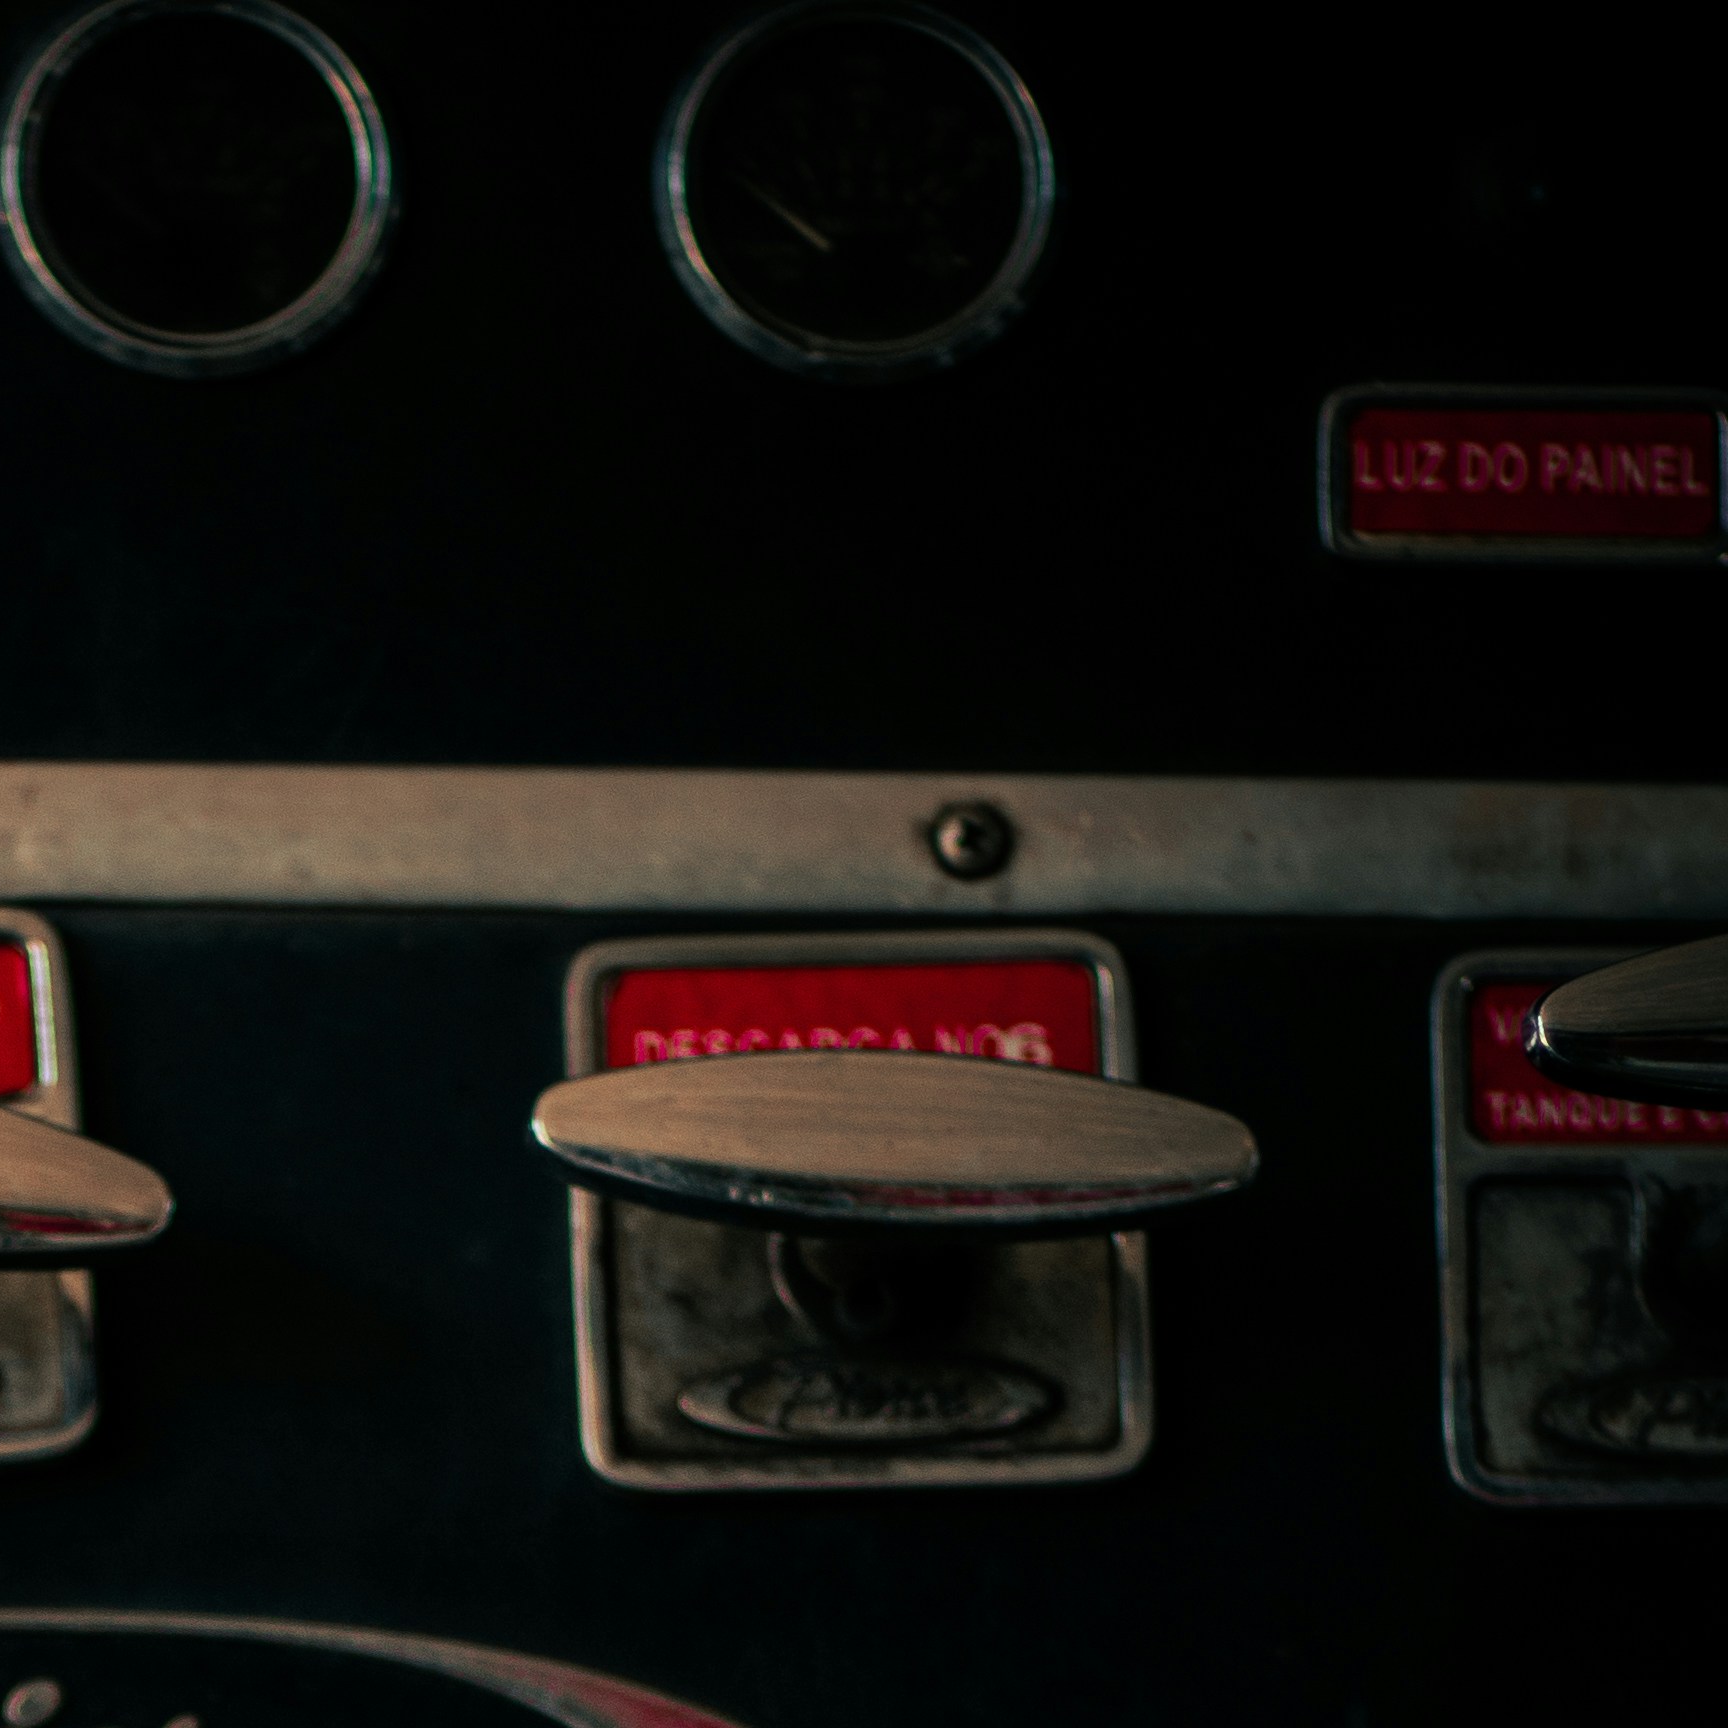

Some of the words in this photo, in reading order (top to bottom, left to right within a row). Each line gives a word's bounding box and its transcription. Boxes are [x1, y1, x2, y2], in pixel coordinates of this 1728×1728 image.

[1353, 439, 1449, 494] LUZ
[1460, 441, 1528, 494] DO
[1543, 443, 1710, 498] PAINEL
[1486, 1091, 1650, 1134] TANQUE
